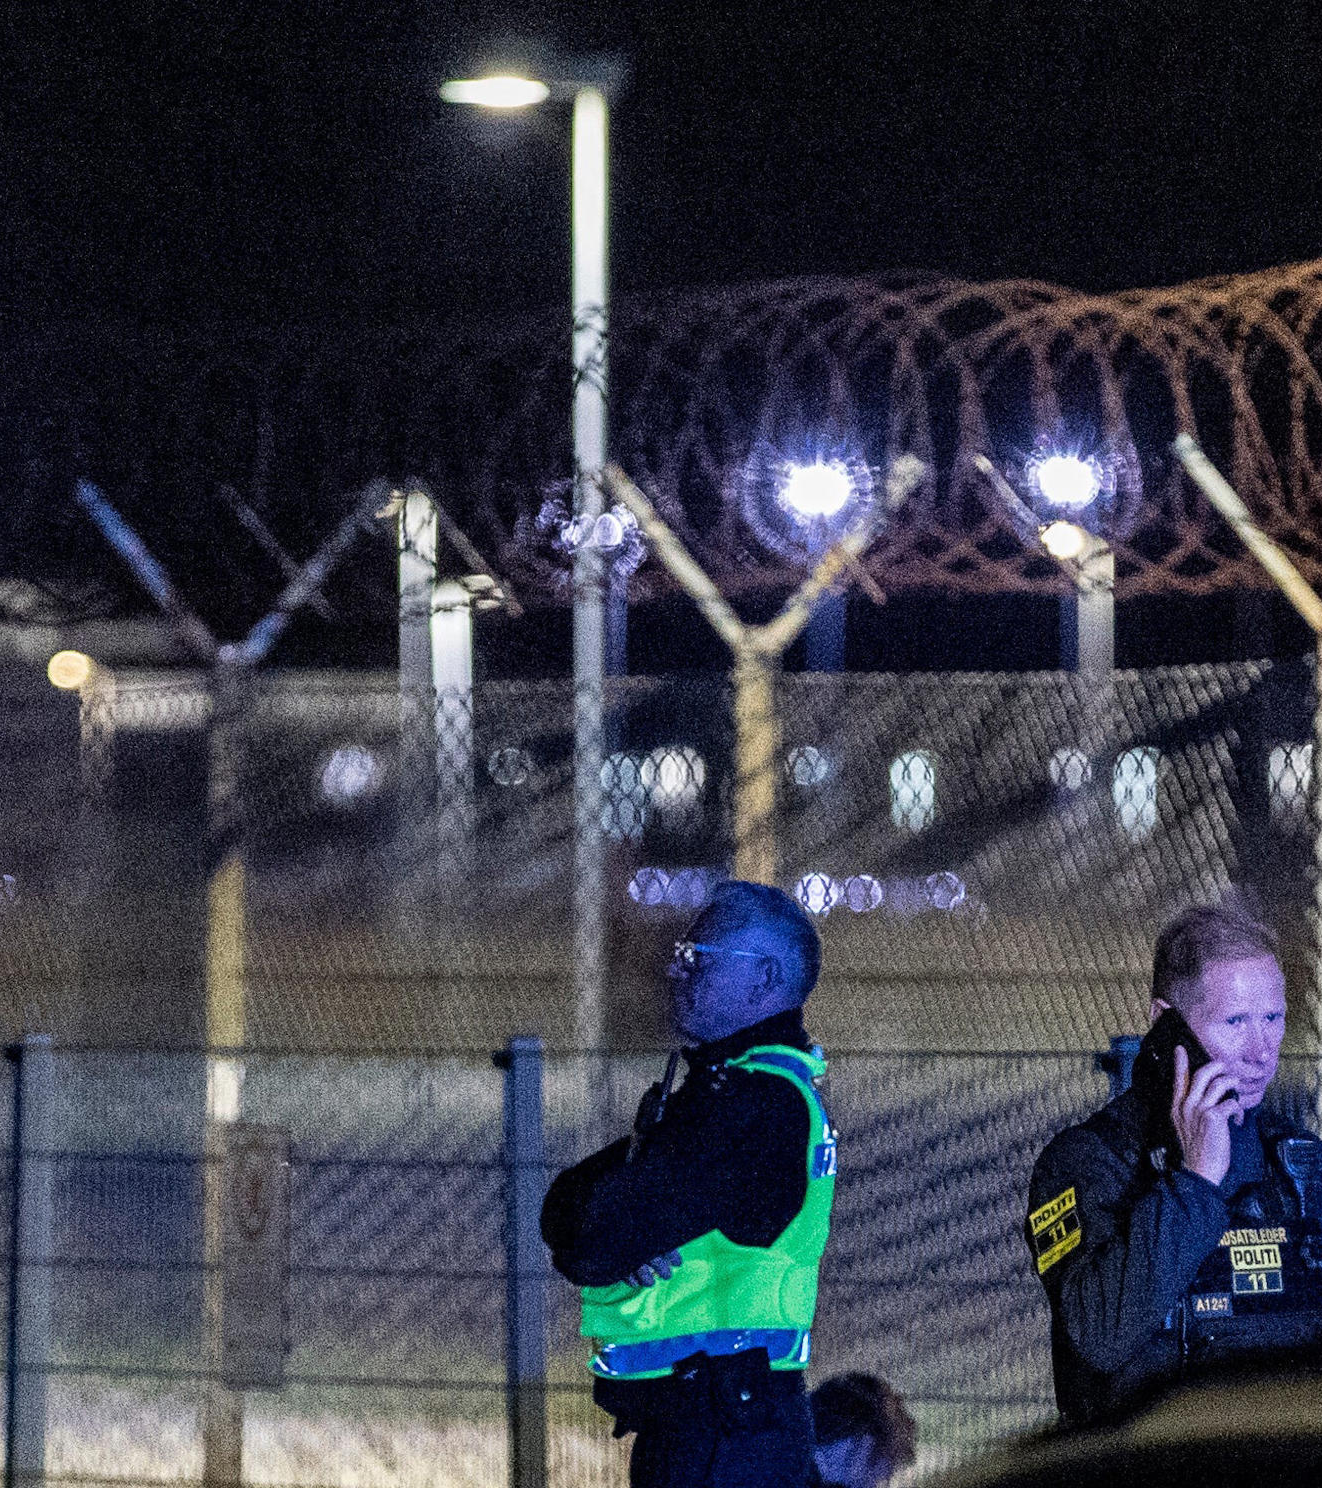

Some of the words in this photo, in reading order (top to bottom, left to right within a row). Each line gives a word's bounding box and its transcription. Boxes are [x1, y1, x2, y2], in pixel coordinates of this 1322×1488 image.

[1034, 1193, 1073, 1227] POLITI
[1234, 1249, 1278, 1266] POLITI
[1249, 1274, 1268, 1290] 11
